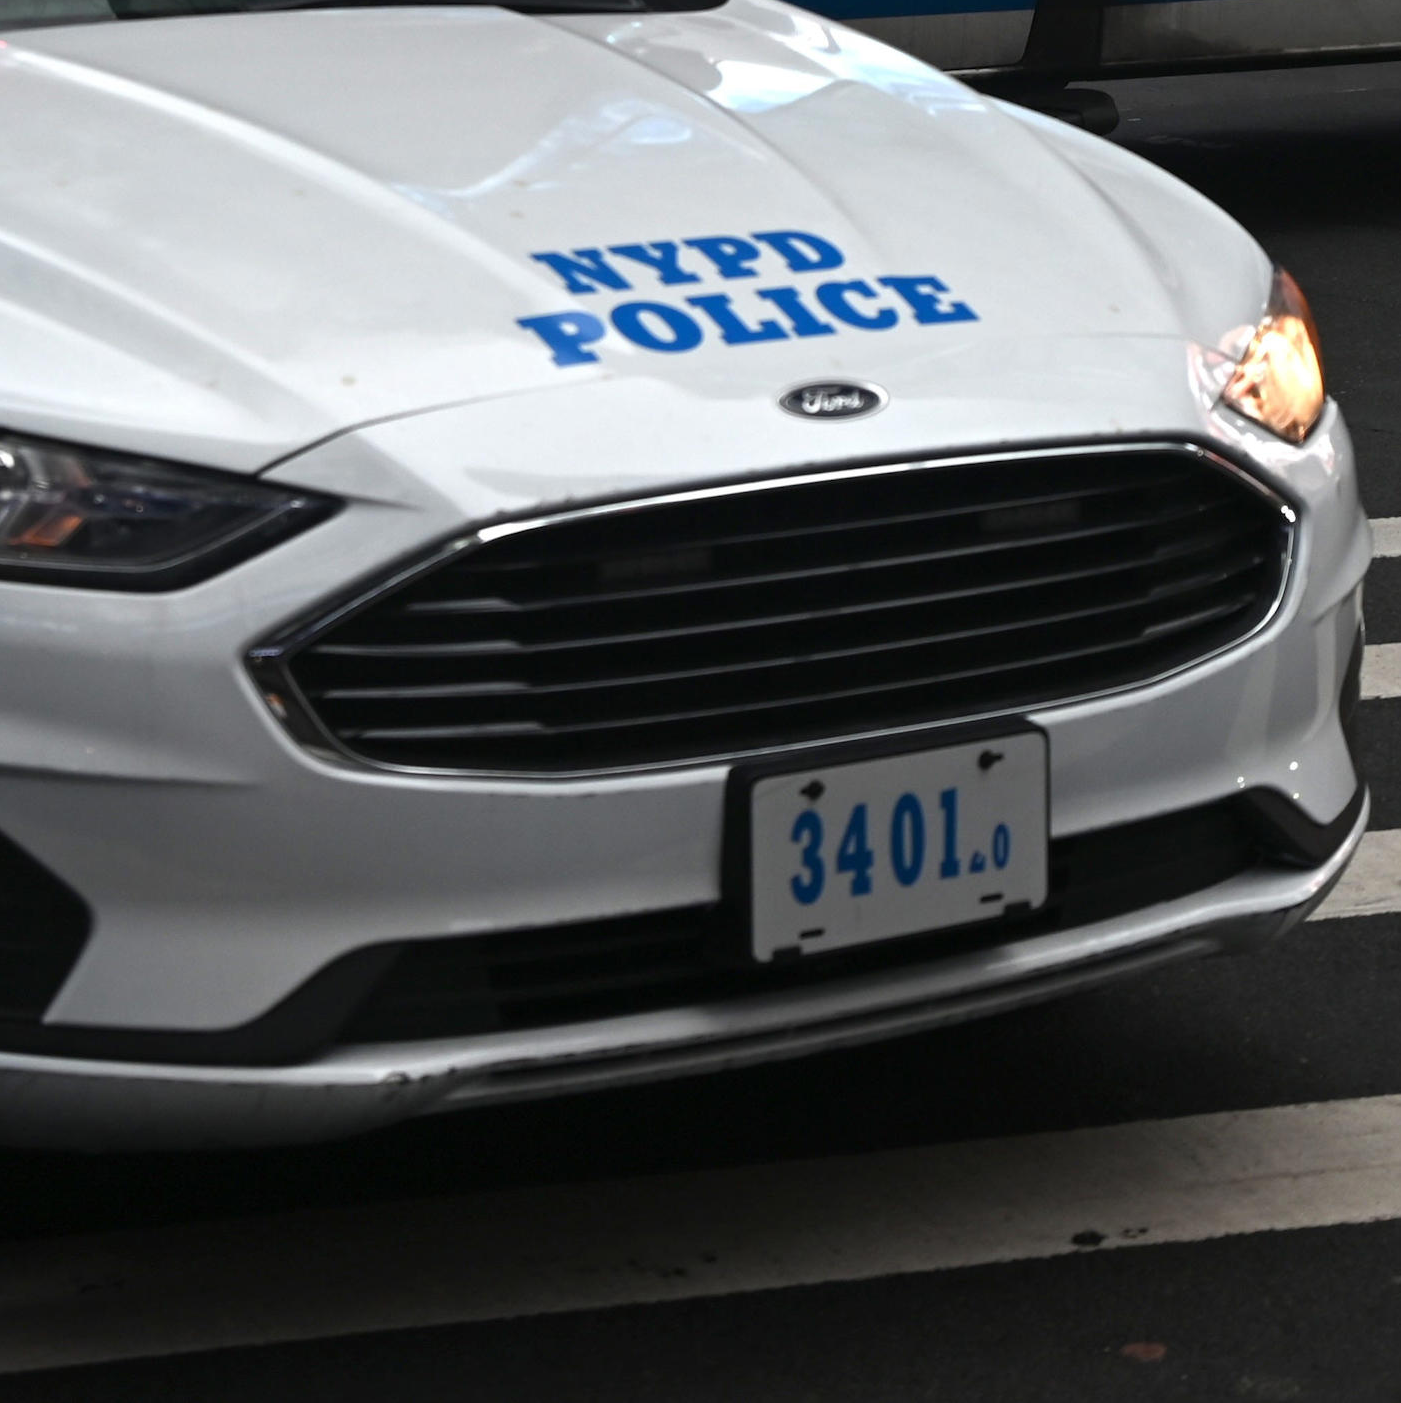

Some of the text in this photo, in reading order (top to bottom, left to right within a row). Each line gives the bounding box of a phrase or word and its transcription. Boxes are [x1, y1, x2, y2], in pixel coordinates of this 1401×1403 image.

[529, 229, 845, 295] NYPD
[515, 274, 980, 368] POLICE
[800, 385, 864, 415] Ford
[791, 786, 960, 904] 3401
